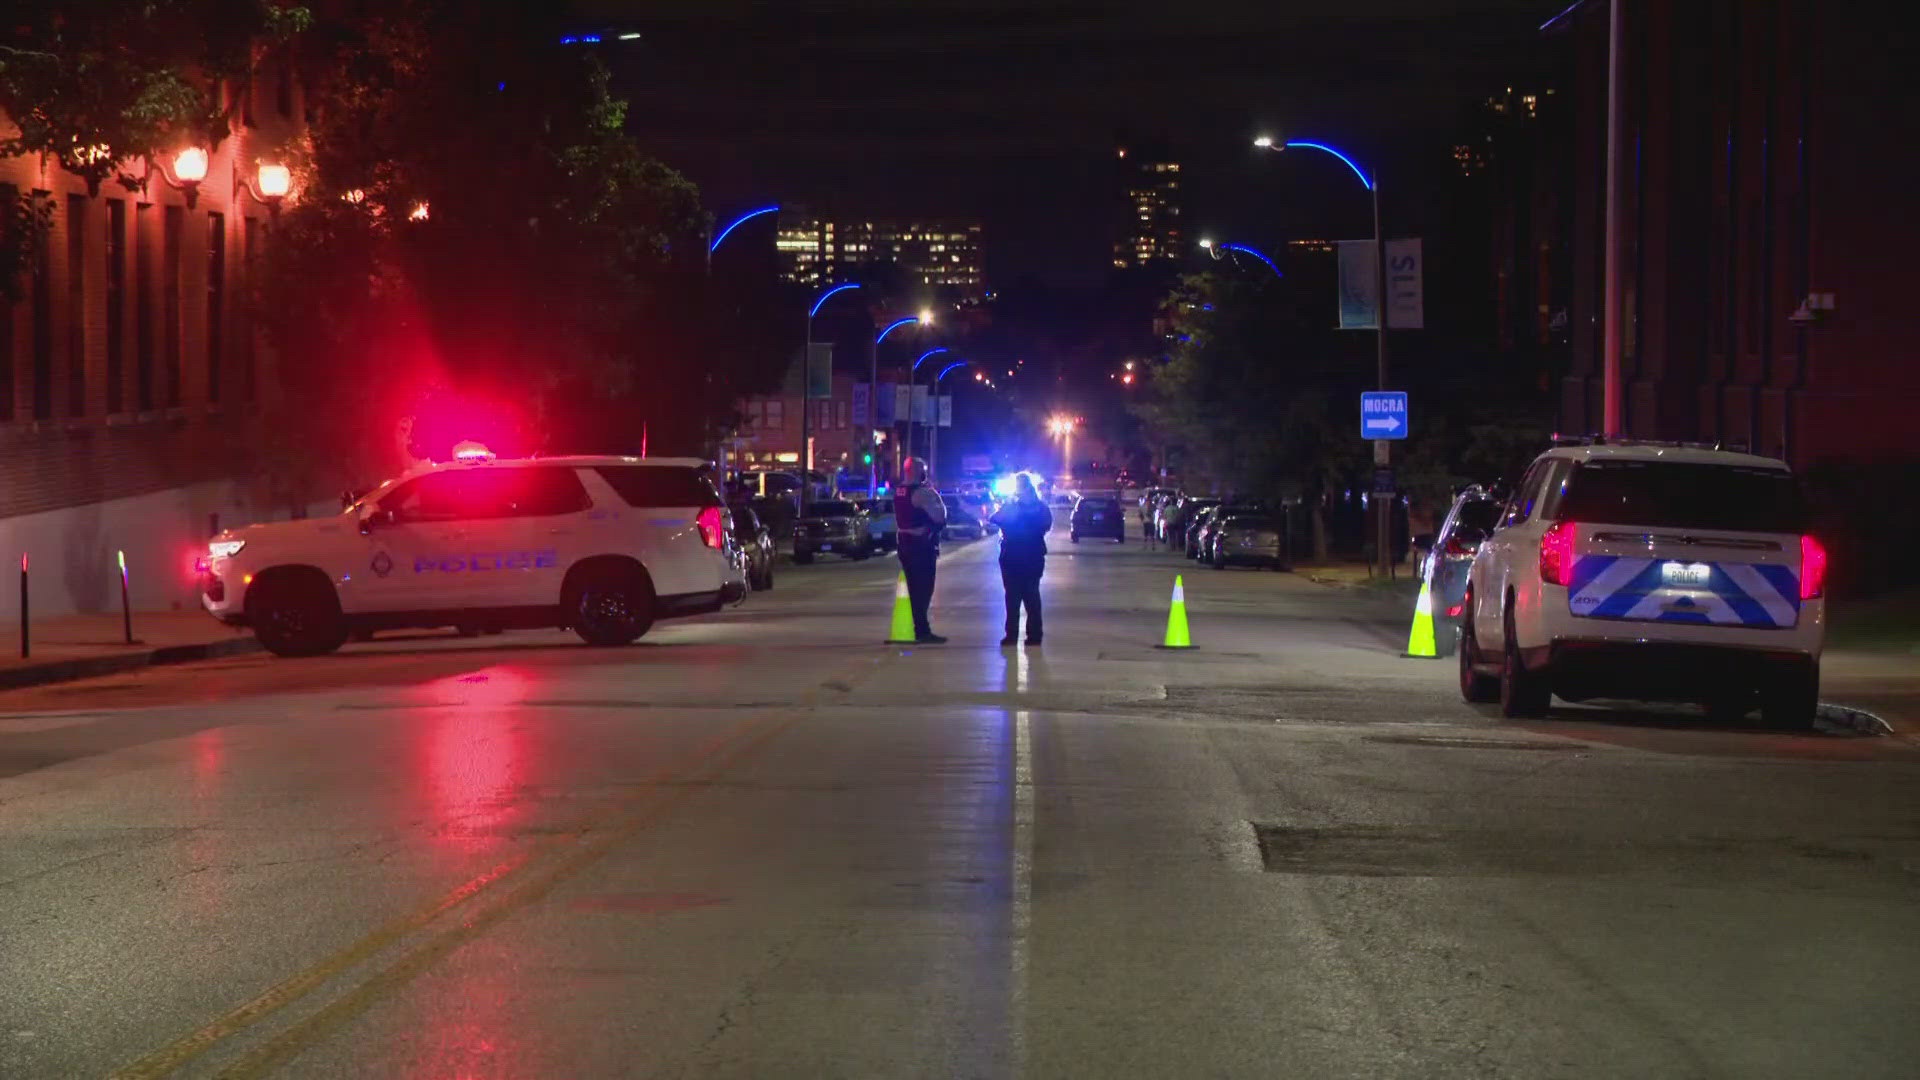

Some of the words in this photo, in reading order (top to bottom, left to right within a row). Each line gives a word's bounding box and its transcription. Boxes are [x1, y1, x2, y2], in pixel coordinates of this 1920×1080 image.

[1364, 398, 1404, 412] MOCRA
[414, 550, 556, 573] POLICE
[1671, 569, 1700, 584] POLICE
